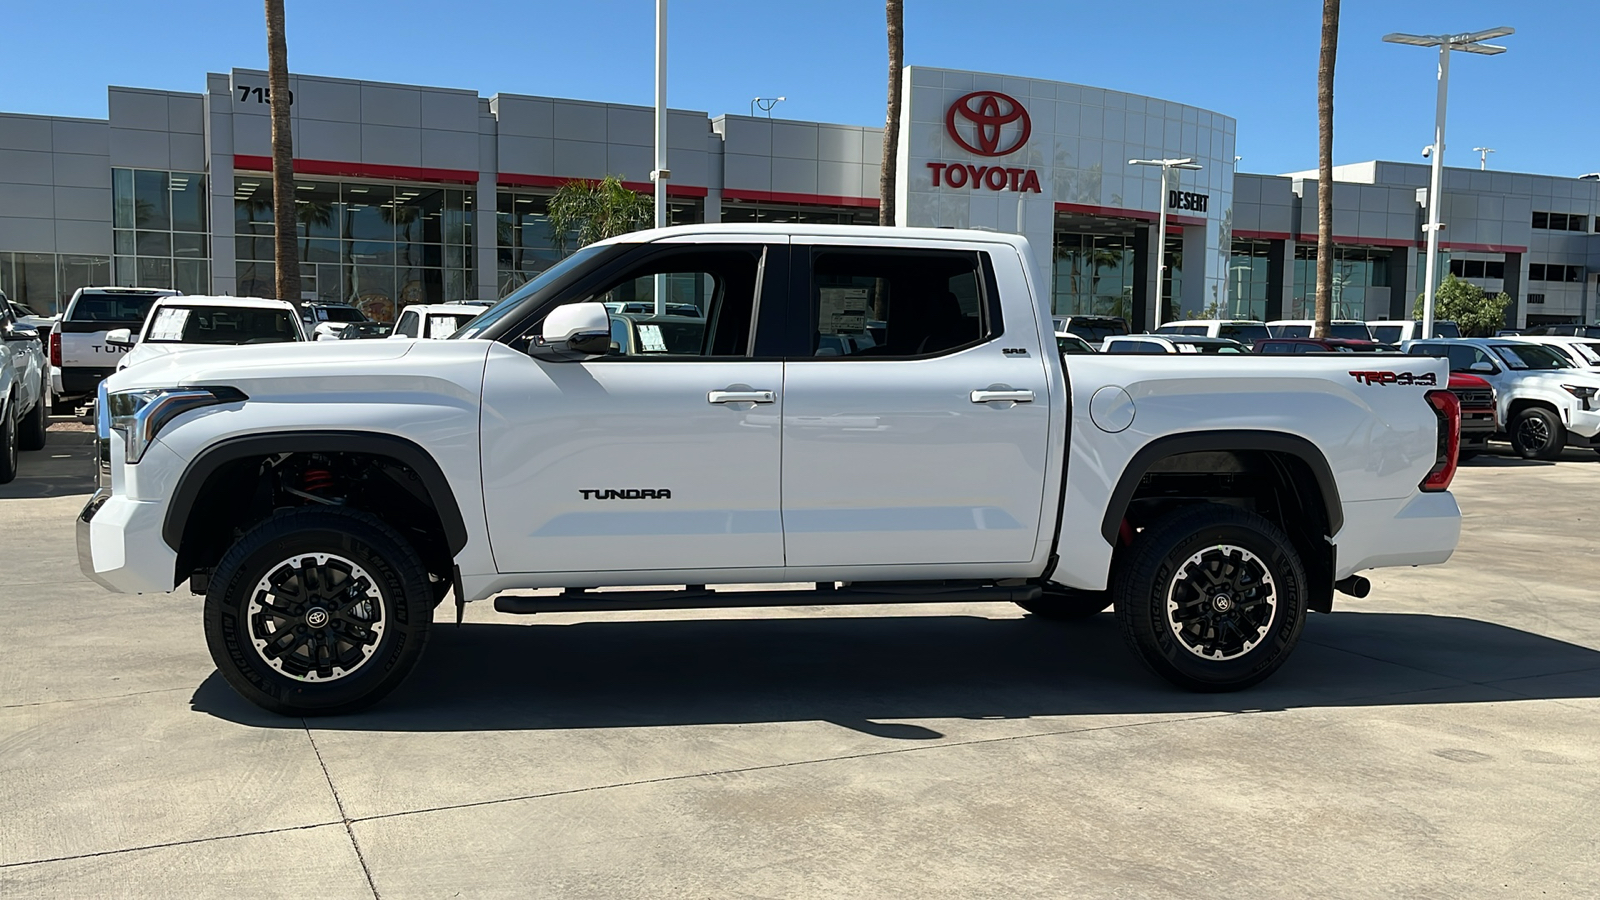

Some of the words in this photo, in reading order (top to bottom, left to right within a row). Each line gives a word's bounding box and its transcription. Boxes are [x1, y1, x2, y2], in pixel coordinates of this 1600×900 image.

[926, 162, 1042, 193] TOYOTA
[1169, 190, 1209, 212] DESERT
[91, 345, 132, 354] TUN
[1348, 371, 1397, 386] TRD
[579, 489, 671, 500] TUNDRA
[371, 555, 407, 623] MICHELIN
[1153, 564, 1169, 632] MICHELIN
[1283, 576, 1297, 640] MICHELIN
[223, 617, 260, 686] MICHELIN
